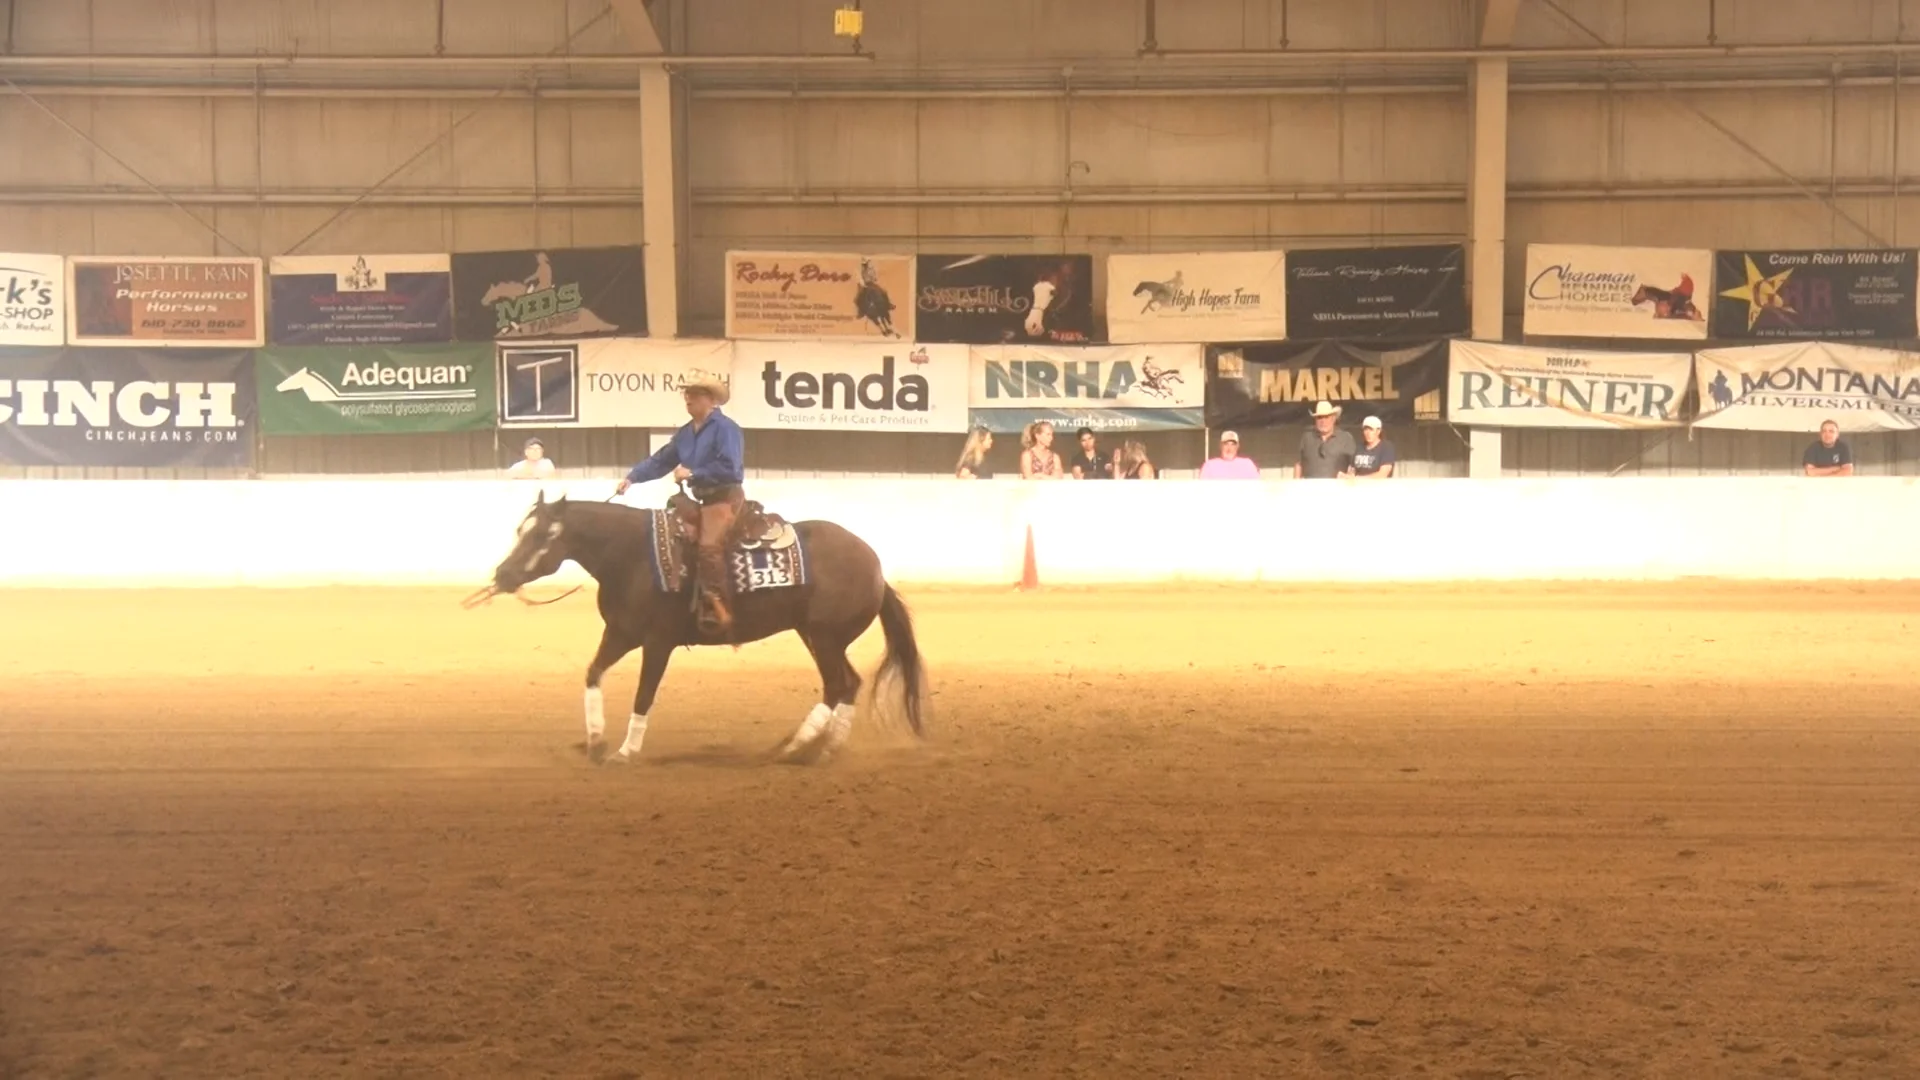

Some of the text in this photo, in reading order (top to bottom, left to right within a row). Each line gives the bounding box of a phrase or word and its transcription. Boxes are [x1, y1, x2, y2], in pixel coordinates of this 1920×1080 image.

[1769, 251, 1906, 265] Come Rein With Us!
[204, 265, 249, 281] KAIN
[736, 261, 797, 292] Rocky
[0, 277, 53, 306] k's
[116, 288, 248, 300] Performance
[1172, 287, 1261, 312] High Hopes Farm
[1560, 291, 1632, 304] HORSES
[5, 307, 54, 321] SHOP
[145, 302, 219, 313] Horses
[341, 362, 467, 390] Adequan
[586, 373, 731, 393] TOYON RAH
[762, 356, 929, 411] tenda
[986, 360, 1137, 399] NRHA
[1259, 365, 1400, 403] MARKEL
[1741, 366, 1920, 400] MONTANA
[0, 380, 237, 428] INCH
[1457, 371, 1676, 420] REINER
[341, 403, 393, 417] polysulfated
[778, 413, 929, 425] Equine & Pet Care Products
[85, 430, 238, 442] CINCHJEANS.COM
[754, 570, 790, 585] 313
